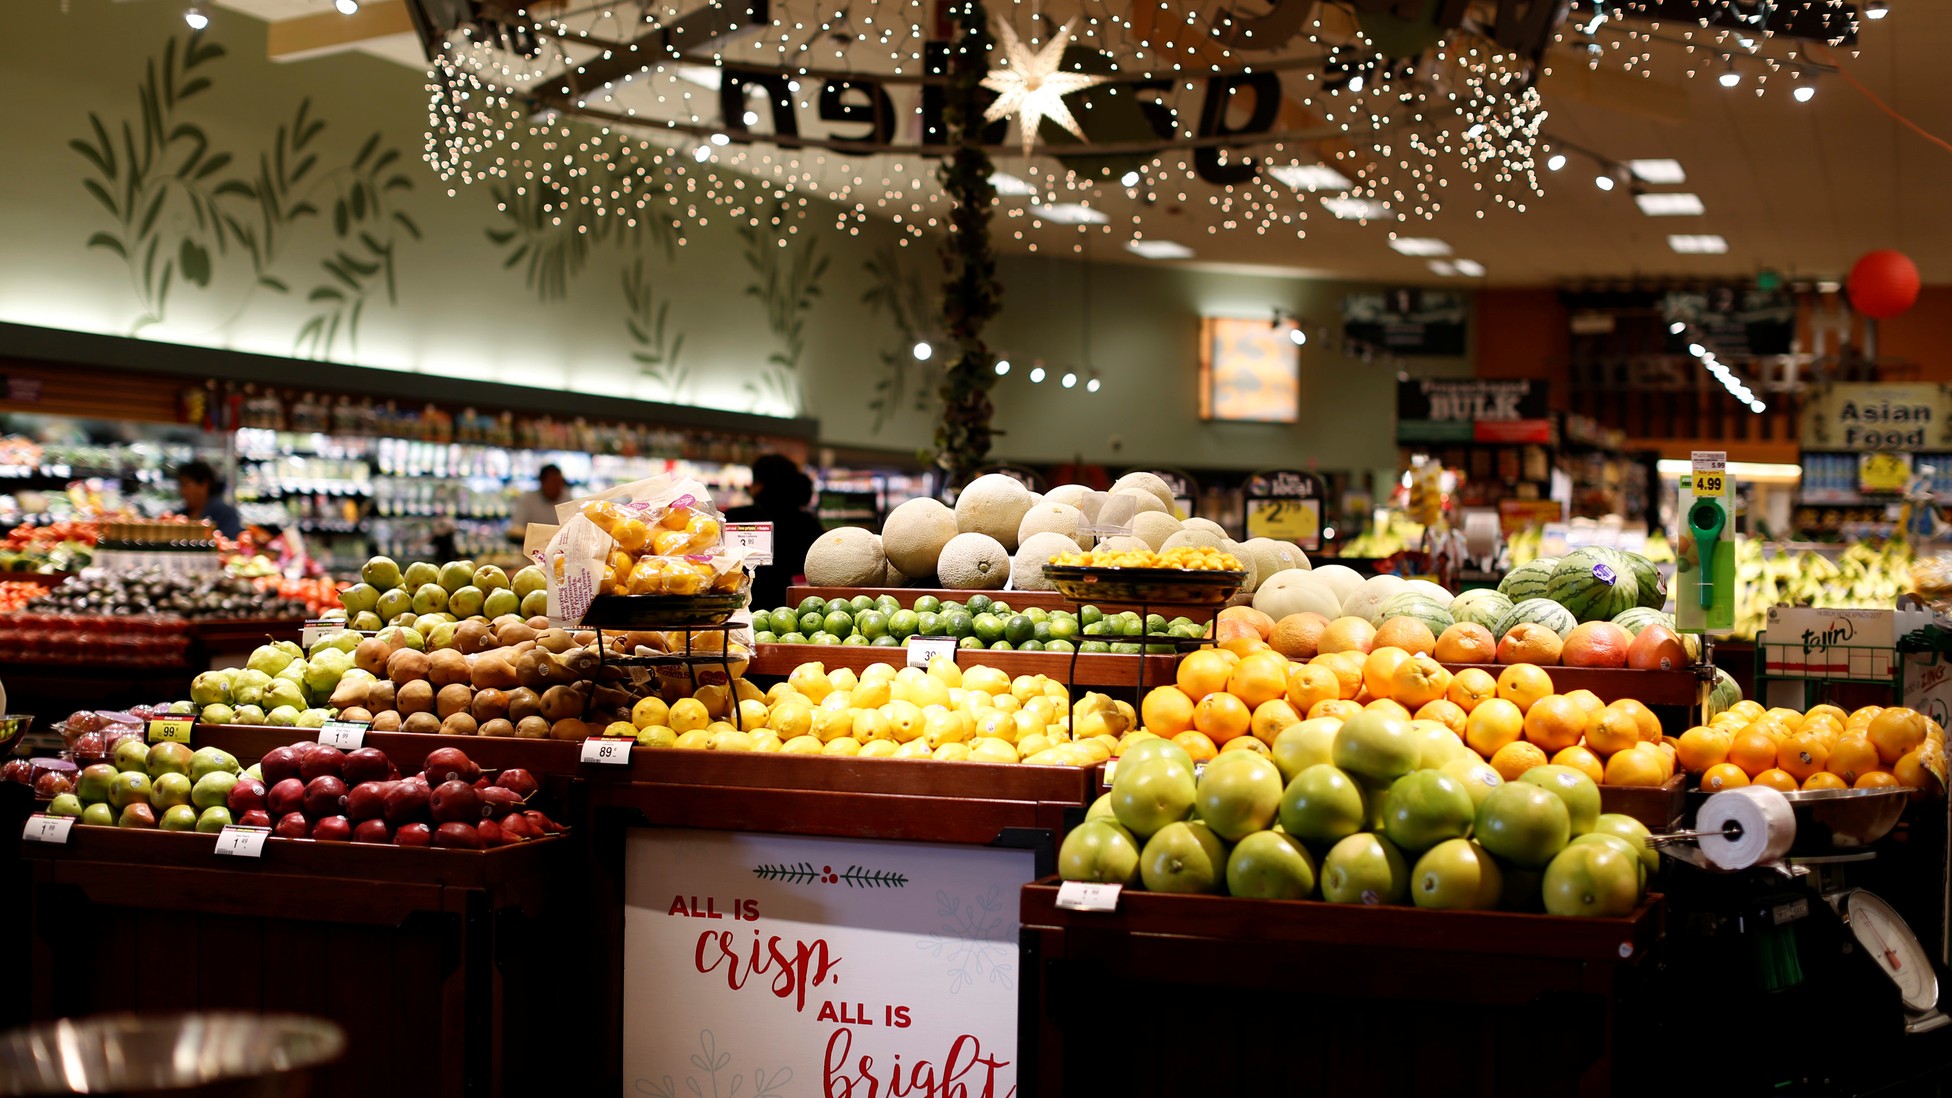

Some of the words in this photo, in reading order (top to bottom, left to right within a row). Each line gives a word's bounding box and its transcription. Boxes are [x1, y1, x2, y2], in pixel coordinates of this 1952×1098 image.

[1428, 394, 1523, 421] BULK
[1839, 399, 1932, 422] Asian
[1845, 426, 1925, 448] Food
[1272, 479, 1313, 497] local
[1696, 477, 1722, 491] 4.99
[558, 587, 567, 622] inspiring
[567, 575, 577, 619] experiences
[163, 726, 175, 737] 99
[599, 746, 612, 758] 89
[41, 824, 46, 835] 1
[234, 838, 238, 848] 1
[668, 895, 723, 920] ALL
[734, 898, 761, 922] IS
[816, 1000, 873, 1025] ALL
[885, 1004, 912, 1028] IS
[823, 1027, 1015, 1098] bright
